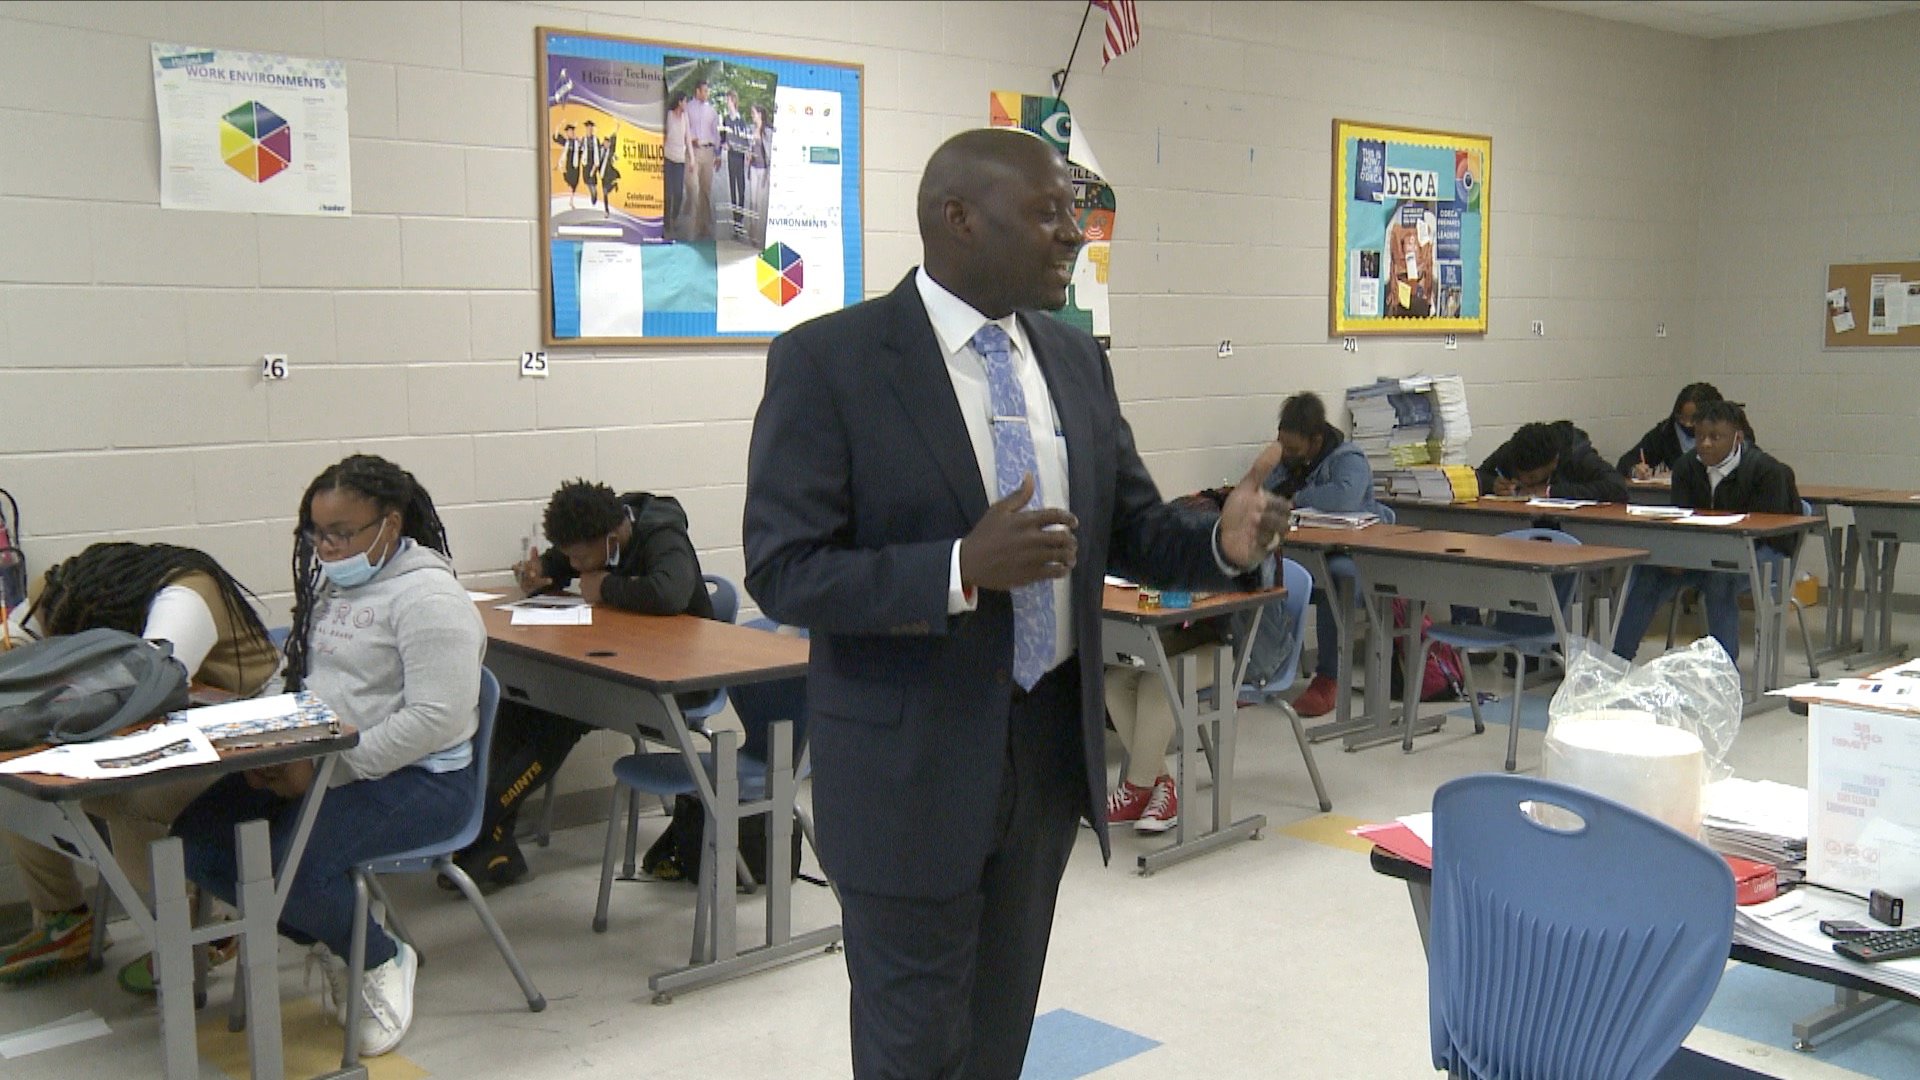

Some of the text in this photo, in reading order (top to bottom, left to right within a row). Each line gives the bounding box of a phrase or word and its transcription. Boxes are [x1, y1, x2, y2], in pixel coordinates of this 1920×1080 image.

[185, 64, 226, 80] WORK
[229, 70, 326, 89] ENVIRONMENTS
[581, 70, 622, 86] Honor
[624, 67, 664, 81] Technic
[637, 143, 664, 160] MILLIO
[1387, 171, 1436, 197] DECA
[768, 217, 828, 229] NVIRONMENTS
[1344, 337, 1356, 352] 20
[524, 351, 546, 371] 25
[500, 761, 543, 807] SAINTS
